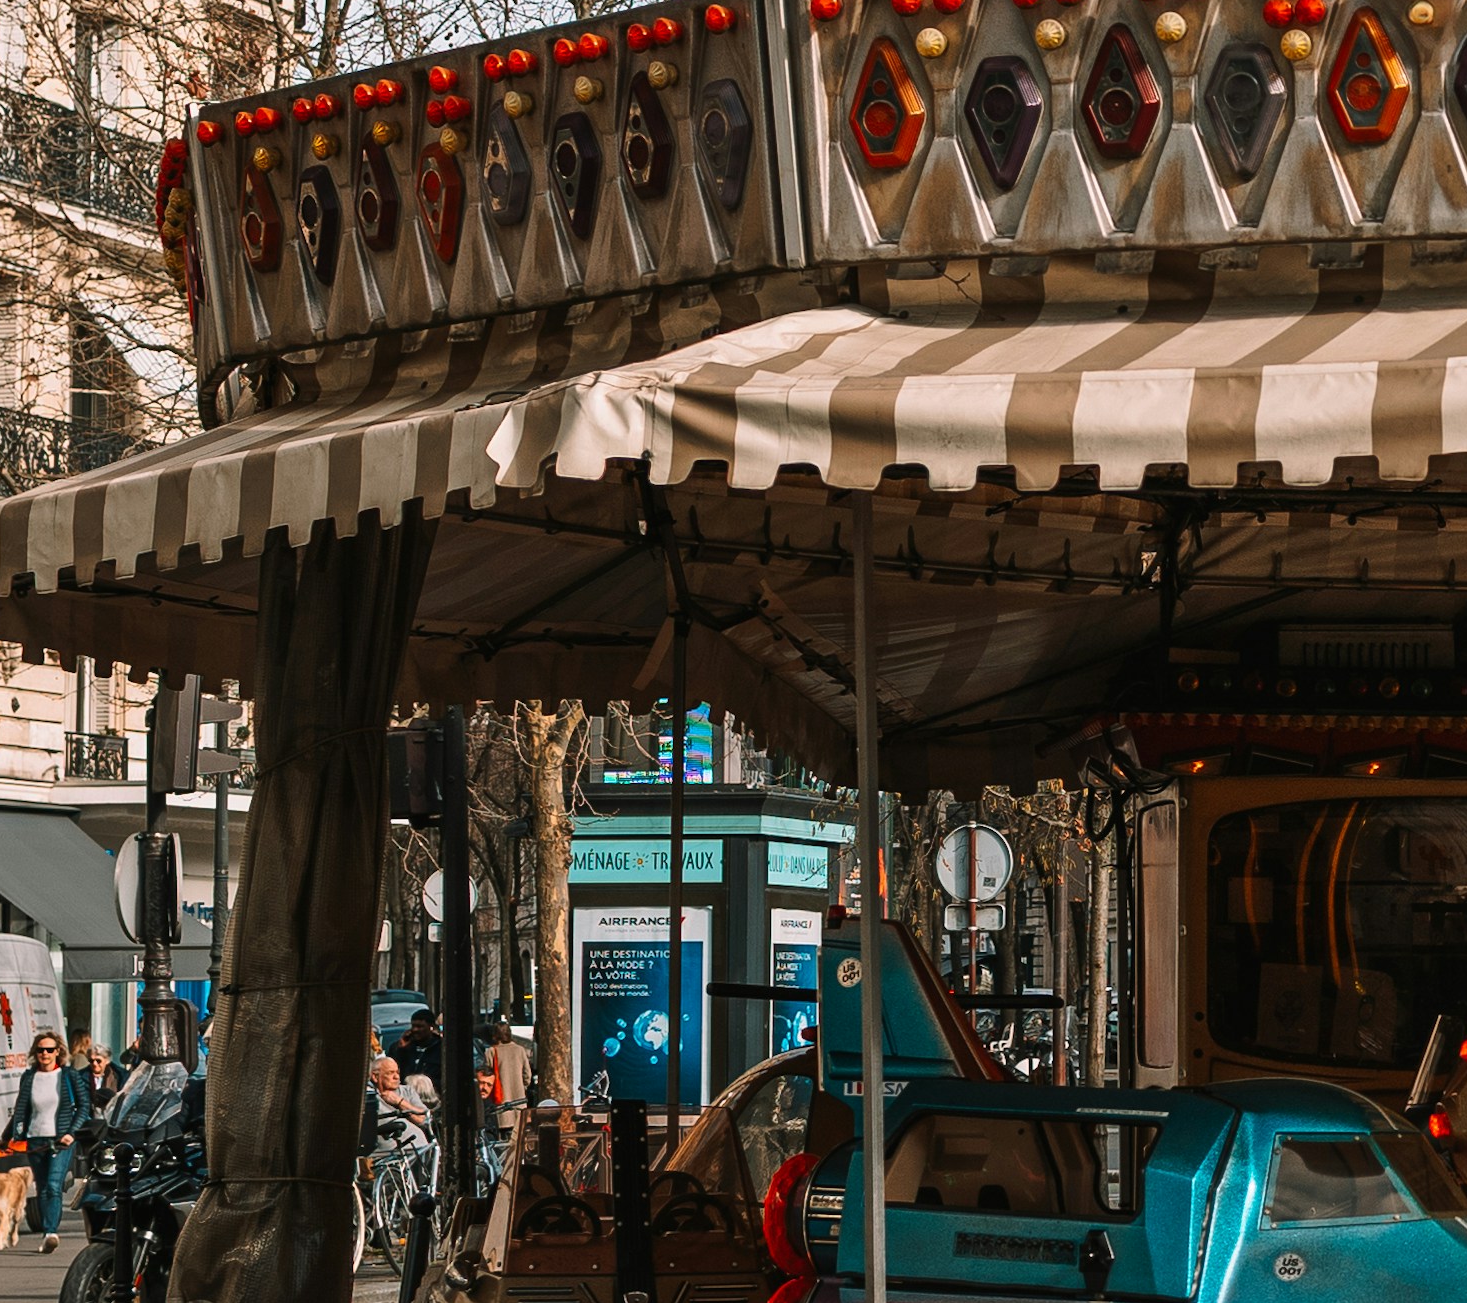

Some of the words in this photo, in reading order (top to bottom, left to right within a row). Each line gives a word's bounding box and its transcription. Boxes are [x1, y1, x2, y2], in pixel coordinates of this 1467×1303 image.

[573, 848, 631, 871] MÉNAGE
[651, 851, 714, 870] TRVAUX
[590, 950, 610, 959] UNE
[600, 960, 614, 970] LA
[617, 960, 645, 970] MODE
[843, 961, 856, 973] US
[589, 971, 603, 980] LA
[1282, 1258, 1299, 1267] US
